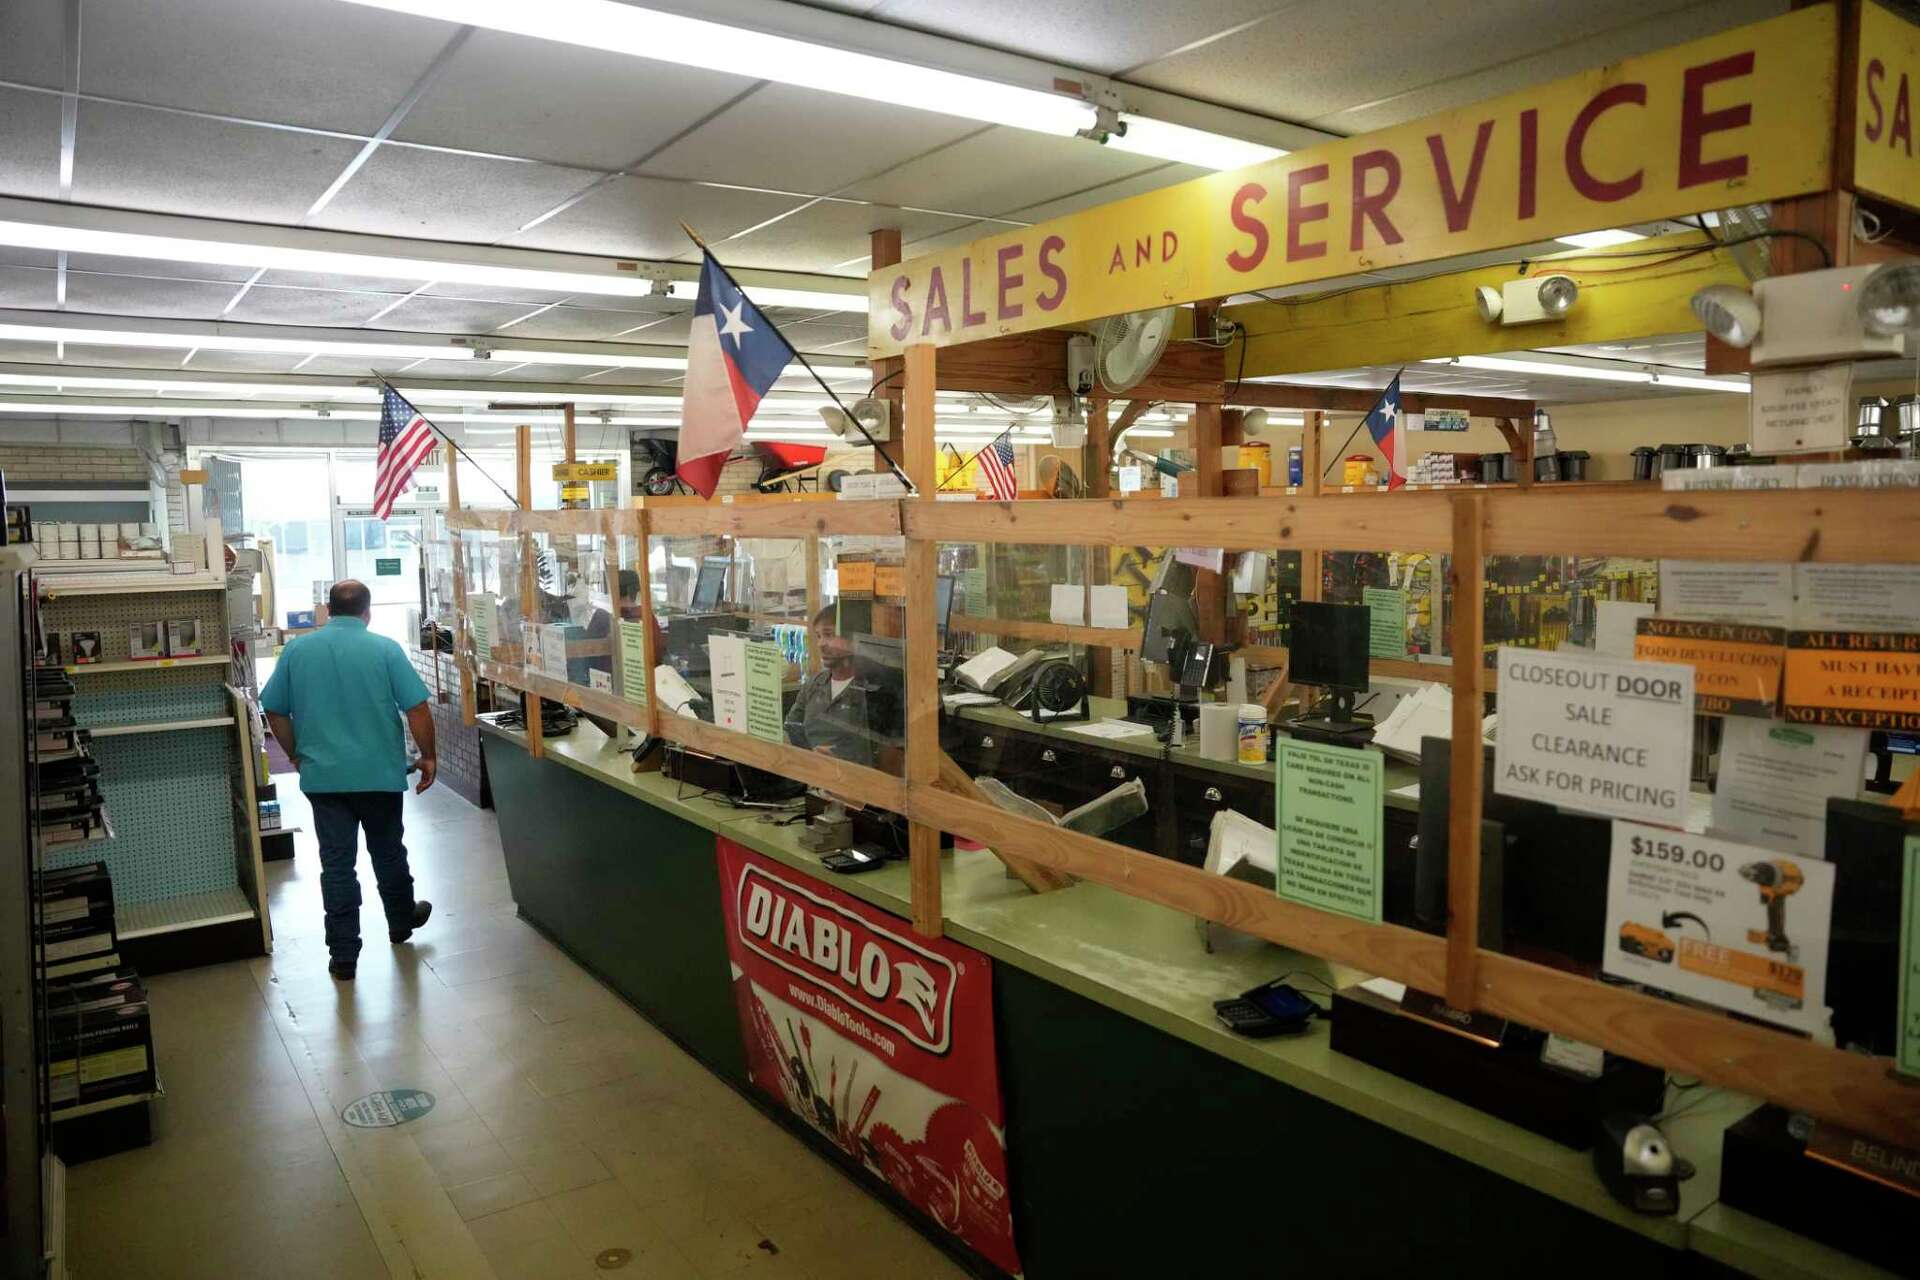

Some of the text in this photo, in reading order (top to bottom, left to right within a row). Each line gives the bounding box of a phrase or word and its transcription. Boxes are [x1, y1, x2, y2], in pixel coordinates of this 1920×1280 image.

[890, 51, 1755, 341] SALES AND SERVICE
[577, 467, 610, 477] CASHIER
[1509, 664, 1682, 701] CLOSEOUT DOOR
[1820, 660, 1868, 673] MUST
[1825, 685, 1836, 696] A
[1565, 703, 1613, 726] SALE
[1788, 706, 1815, 721] NO
[1532, 733, 1648, 767] CLEARANCE
[1506, 764, 1676, 809] ASK FOR PRICING
[1631, 836, 1725, 873] $159.00
[747, 881, 890, 998] DIABLO
[789, 983, 895, 1057] www.DiabloTools.com
